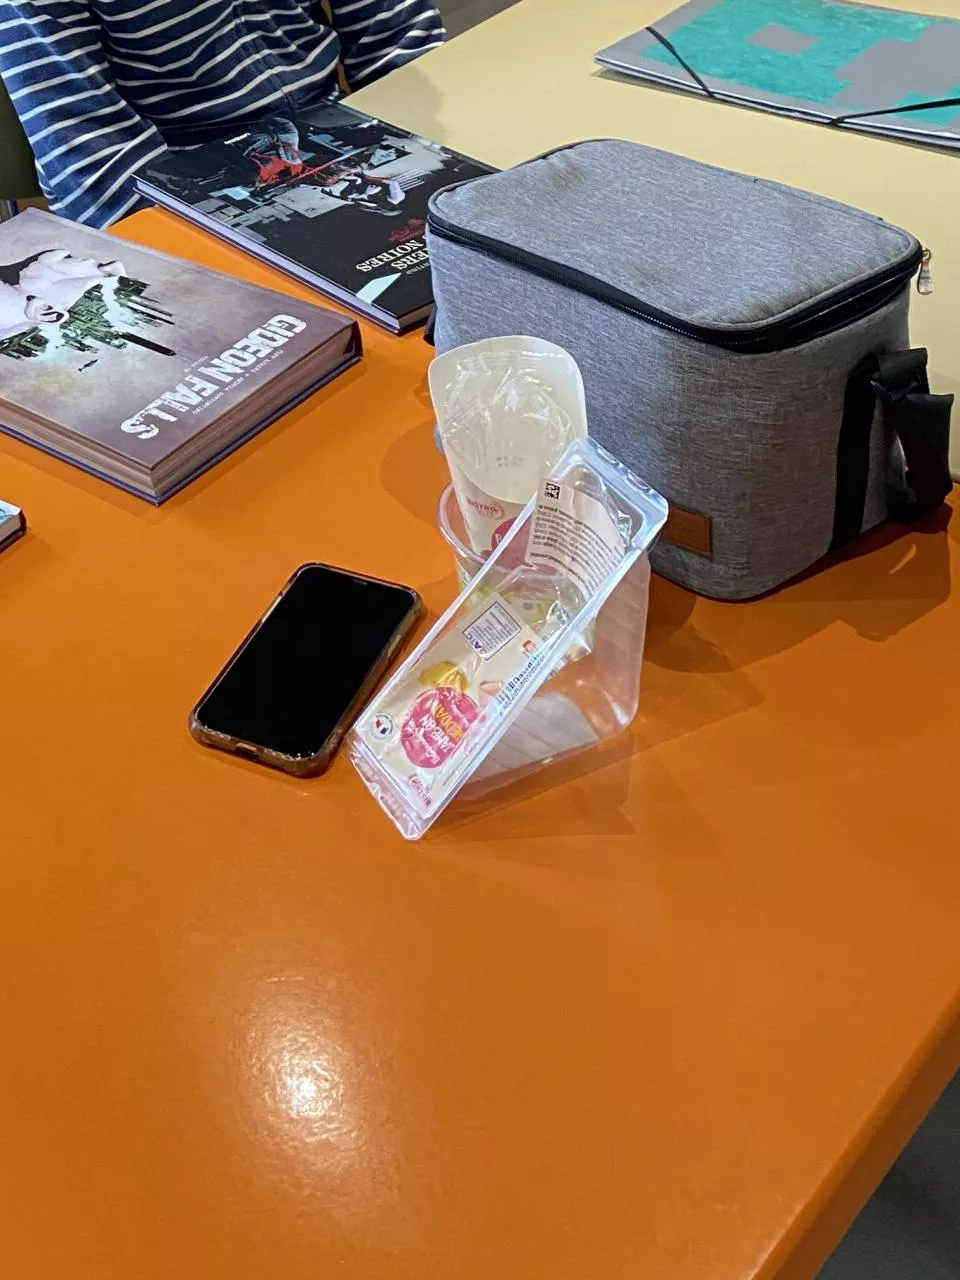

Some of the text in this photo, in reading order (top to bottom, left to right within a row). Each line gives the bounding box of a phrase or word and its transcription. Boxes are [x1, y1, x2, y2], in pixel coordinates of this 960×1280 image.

[355, 239, 425, 272] NOIRES
[391, 247, 430, 270] ERS
[198, 314, 308, 383] GIDEON
[120, 375, 220, 440] FALLS
